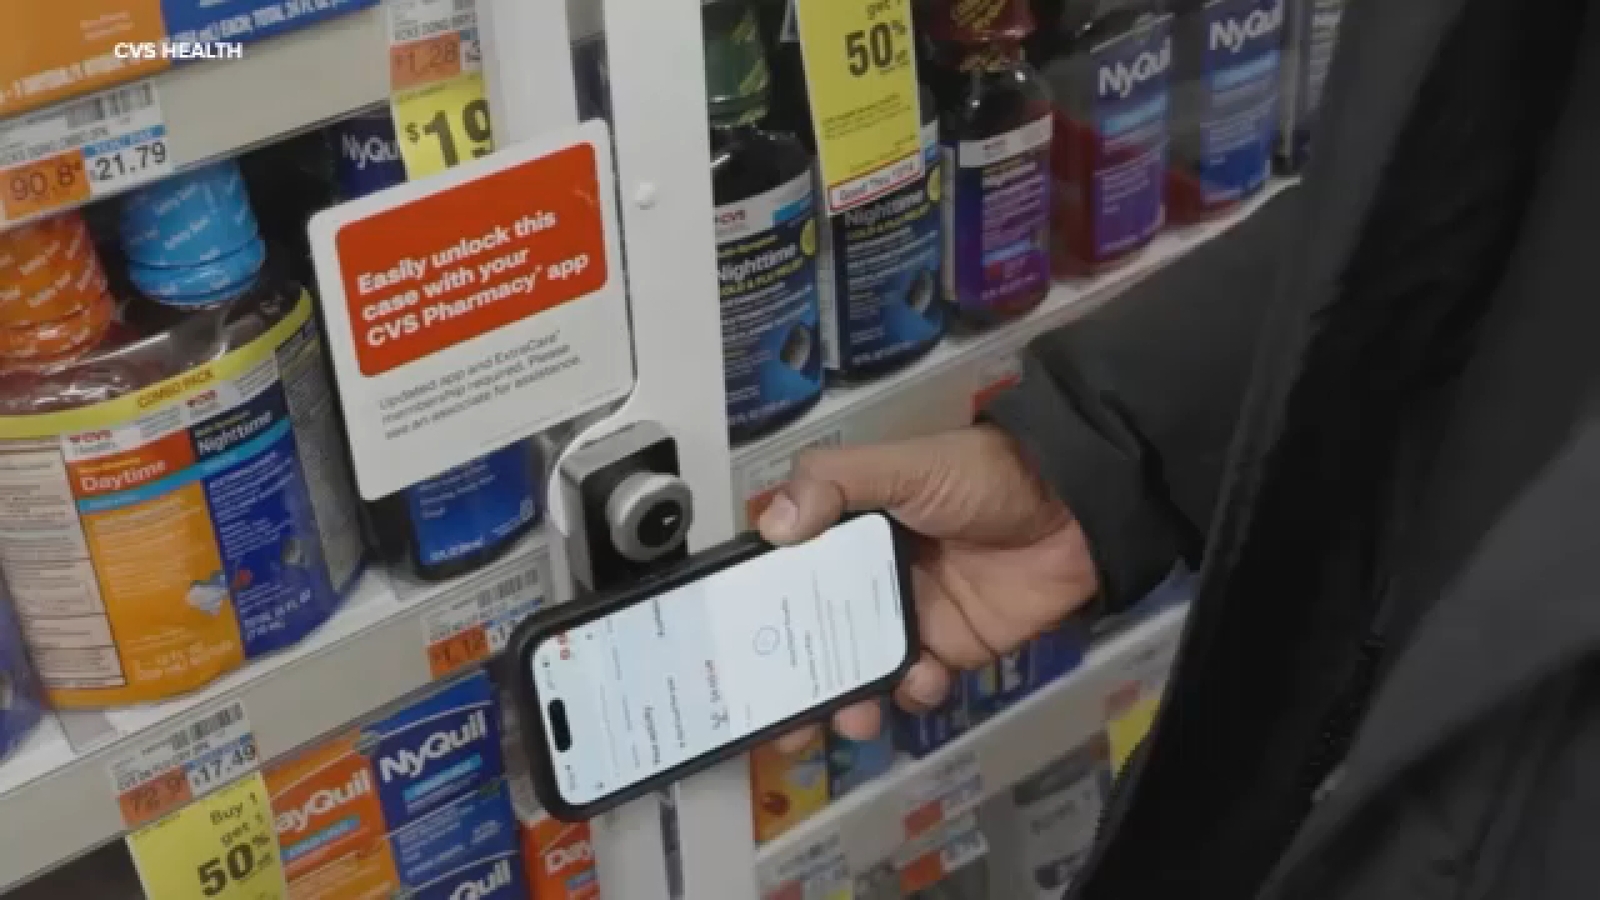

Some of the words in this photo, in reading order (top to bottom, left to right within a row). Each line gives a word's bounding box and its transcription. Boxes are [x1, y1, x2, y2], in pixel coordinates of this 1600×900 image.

[341, 133, 400, 170] NyQu
[357, 256, 428, 296] Easily
[431, 223, 510, 271] unlock
[514, 209, 557, 239] this
[362, 288, 420, 322] case
[422, 265, 476, 299] with
[478, 247, 530, 286] your
[365, 313, 420, 348] CVS
[546, 251, 590, 283] app
[181, 368, 215, 395] PACK
[379, 376, 438, 412] Updated
[439, 369, 467, 392] app
[465, 355, 493, 378] and
[381, 381, 467, 426] membership
[528, 341, 571, 369] Please
[386, 424, 409, 441] see
[410, 417, 431, 433] an
[430, 387, 492, 425] associate
[493, 379, 512, 398] for
[197, 411, 272, 456] Nighttime
[80, 460, 166, 492] Daytime
[379, 708, 488, 785] NyQuil
[209, 802, 244, 826] Buy
[276, 767, 371, 834] ayQuil
[220, 822, 251, 849] get
